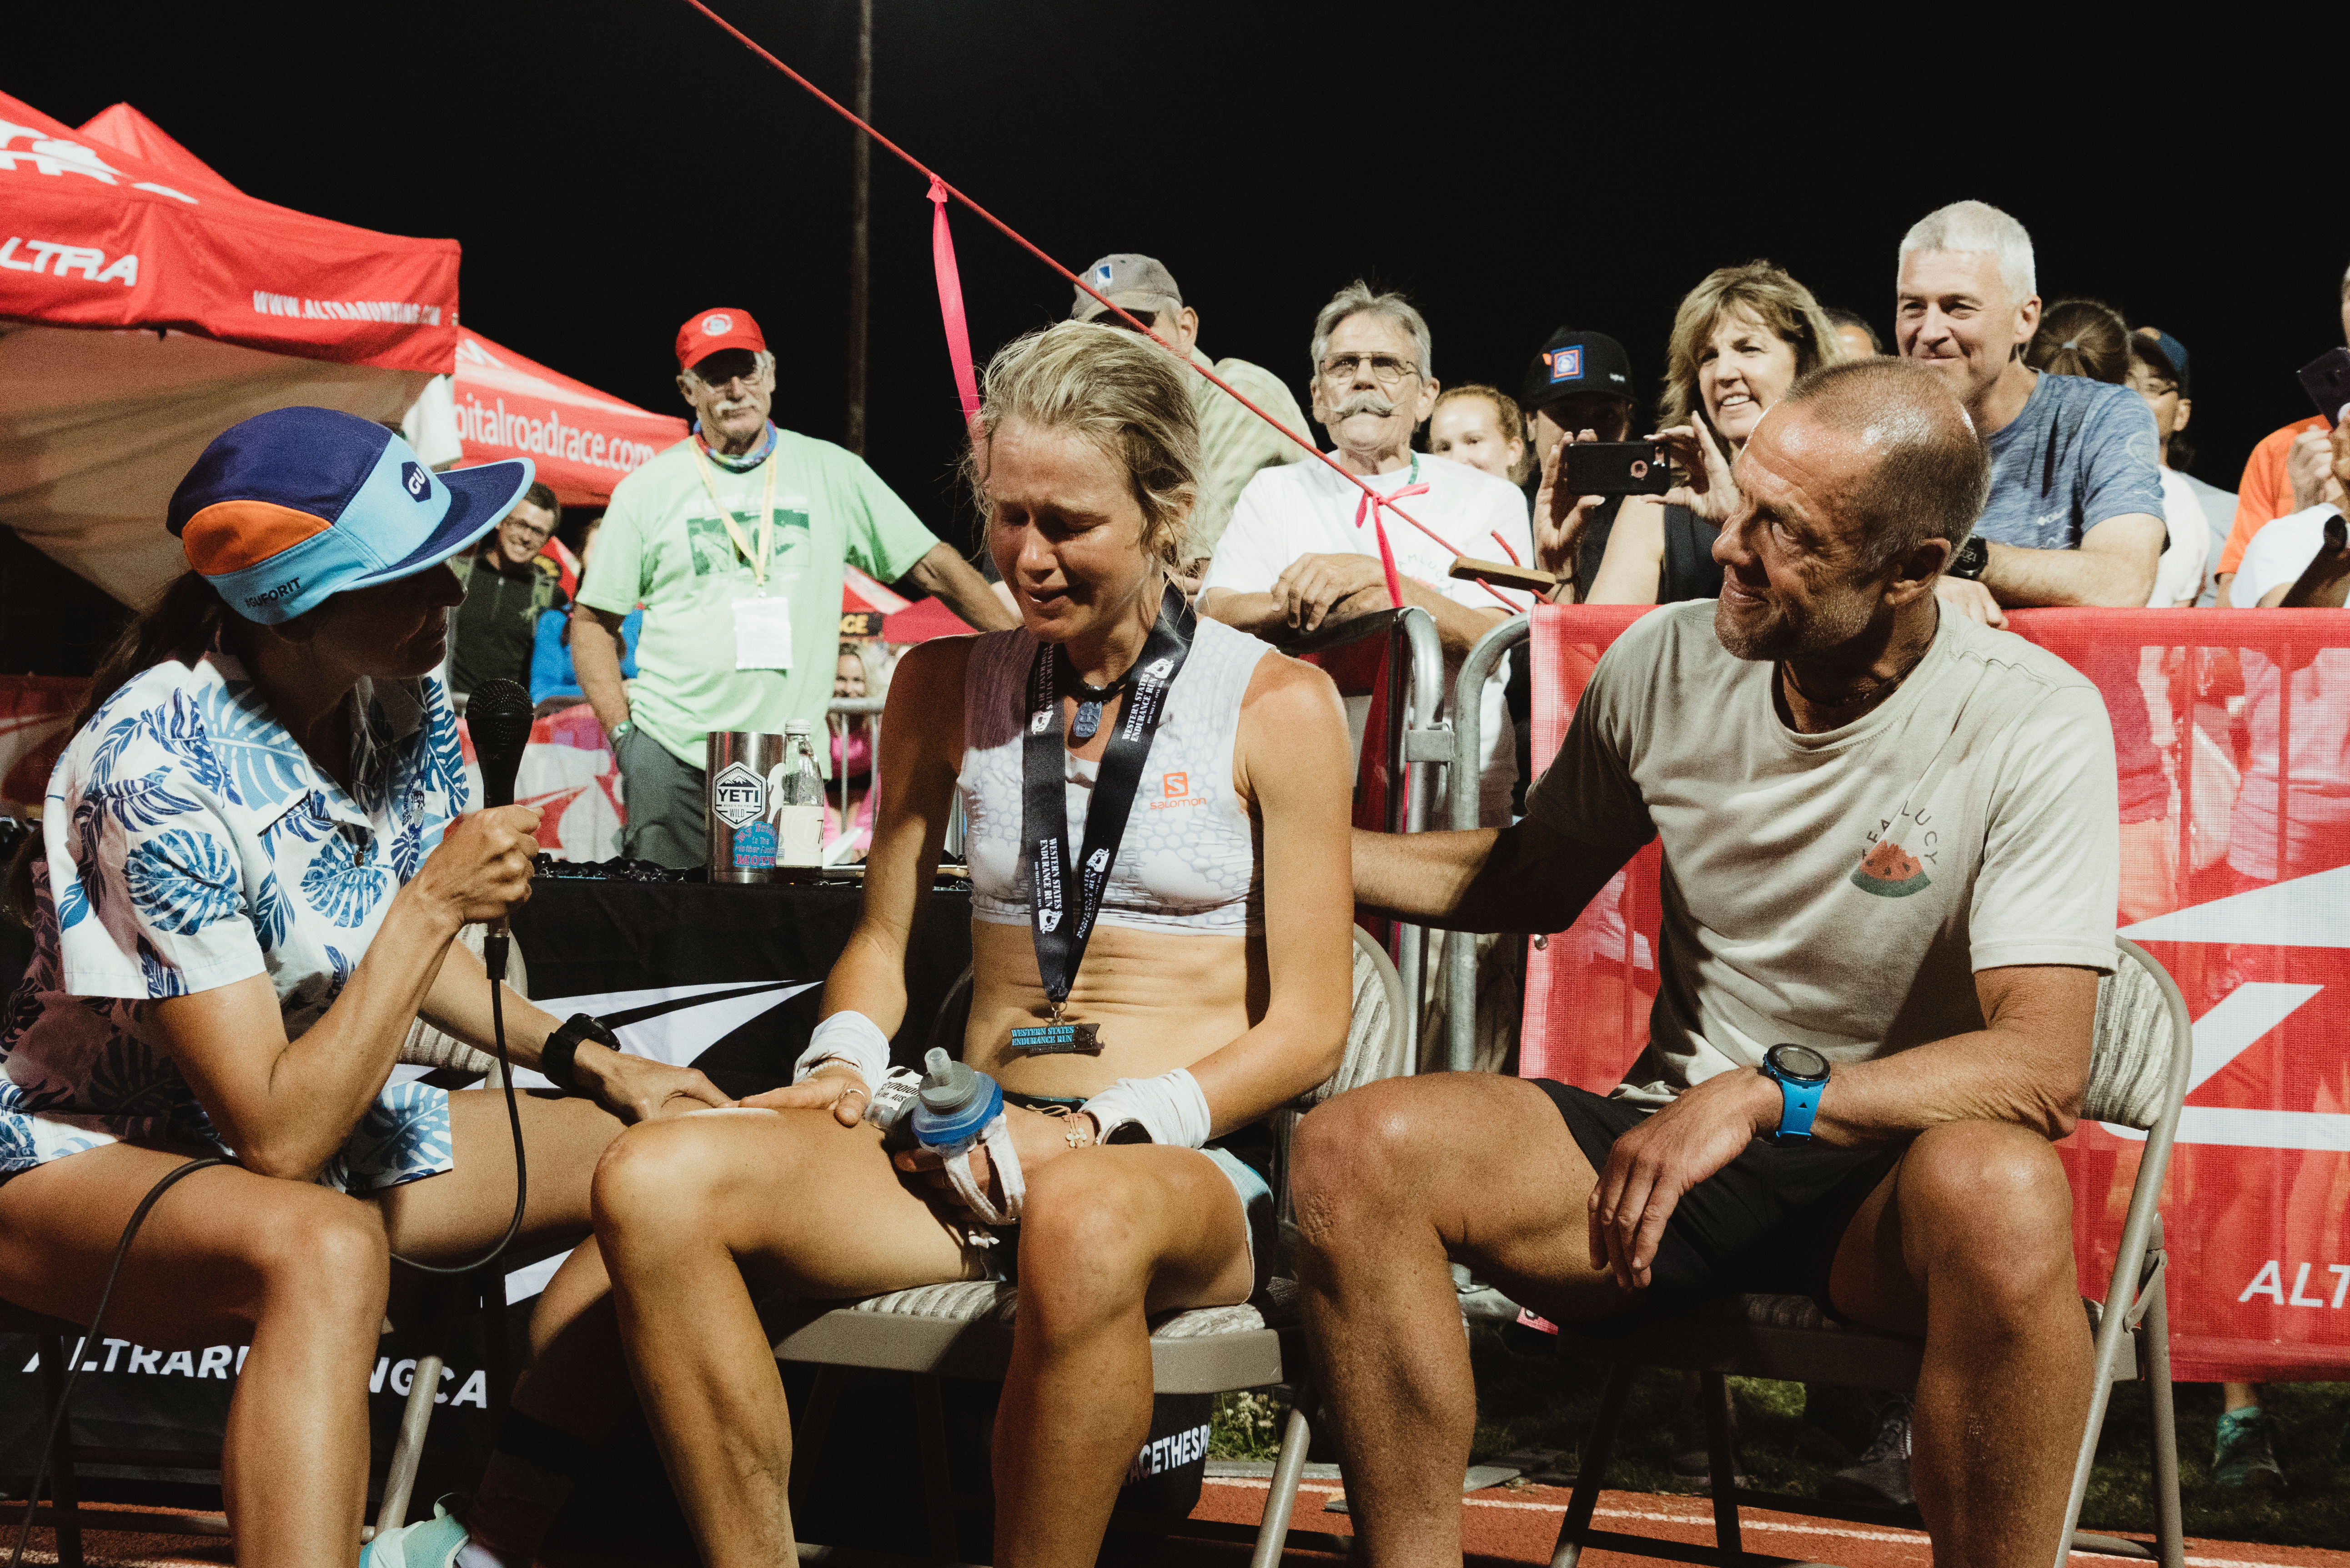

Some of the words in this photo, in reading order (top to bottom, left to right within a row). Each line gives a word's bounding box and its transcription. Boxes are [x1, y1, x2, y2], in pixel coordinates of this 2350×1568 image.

[0, 237, 138, 286] LTRA
[409, 467, 425, 494] GU
[245, 577, 300, 608] #GUFORIT
[1122, 703, 1140, 739] WESTERN
[1135, 673, 1150, 701] STATES
[1130, 695, 1151, 742] ENDURANCE
[1145, 678, 1158, 694] RUN
[717, 789, 759, 803] YETI
[729, 809, 744, 818] WILD
[1901, 800, 1938, 864] LUCY
[1040, 839, 1051, 888] ENDURANCE
[1049, 837, 1060, 877] WESTERN
[1052, 879, 1062, 910] STATES
[1089, 872, 1097, 890] RUN
[1044, 890, 1053, 907] RUN
[1011, 1027, 1046, 1037] WESTERN
[1047, 1025, 1075, 1035] STATES
[1012, 1035, 1055, 1046] ENDURANCE
[1057, 1034, 1073, 1043] RUN
[889, 1094, 907, 1102] AUS
[2238, 1260, 2350, 1309] ALT
